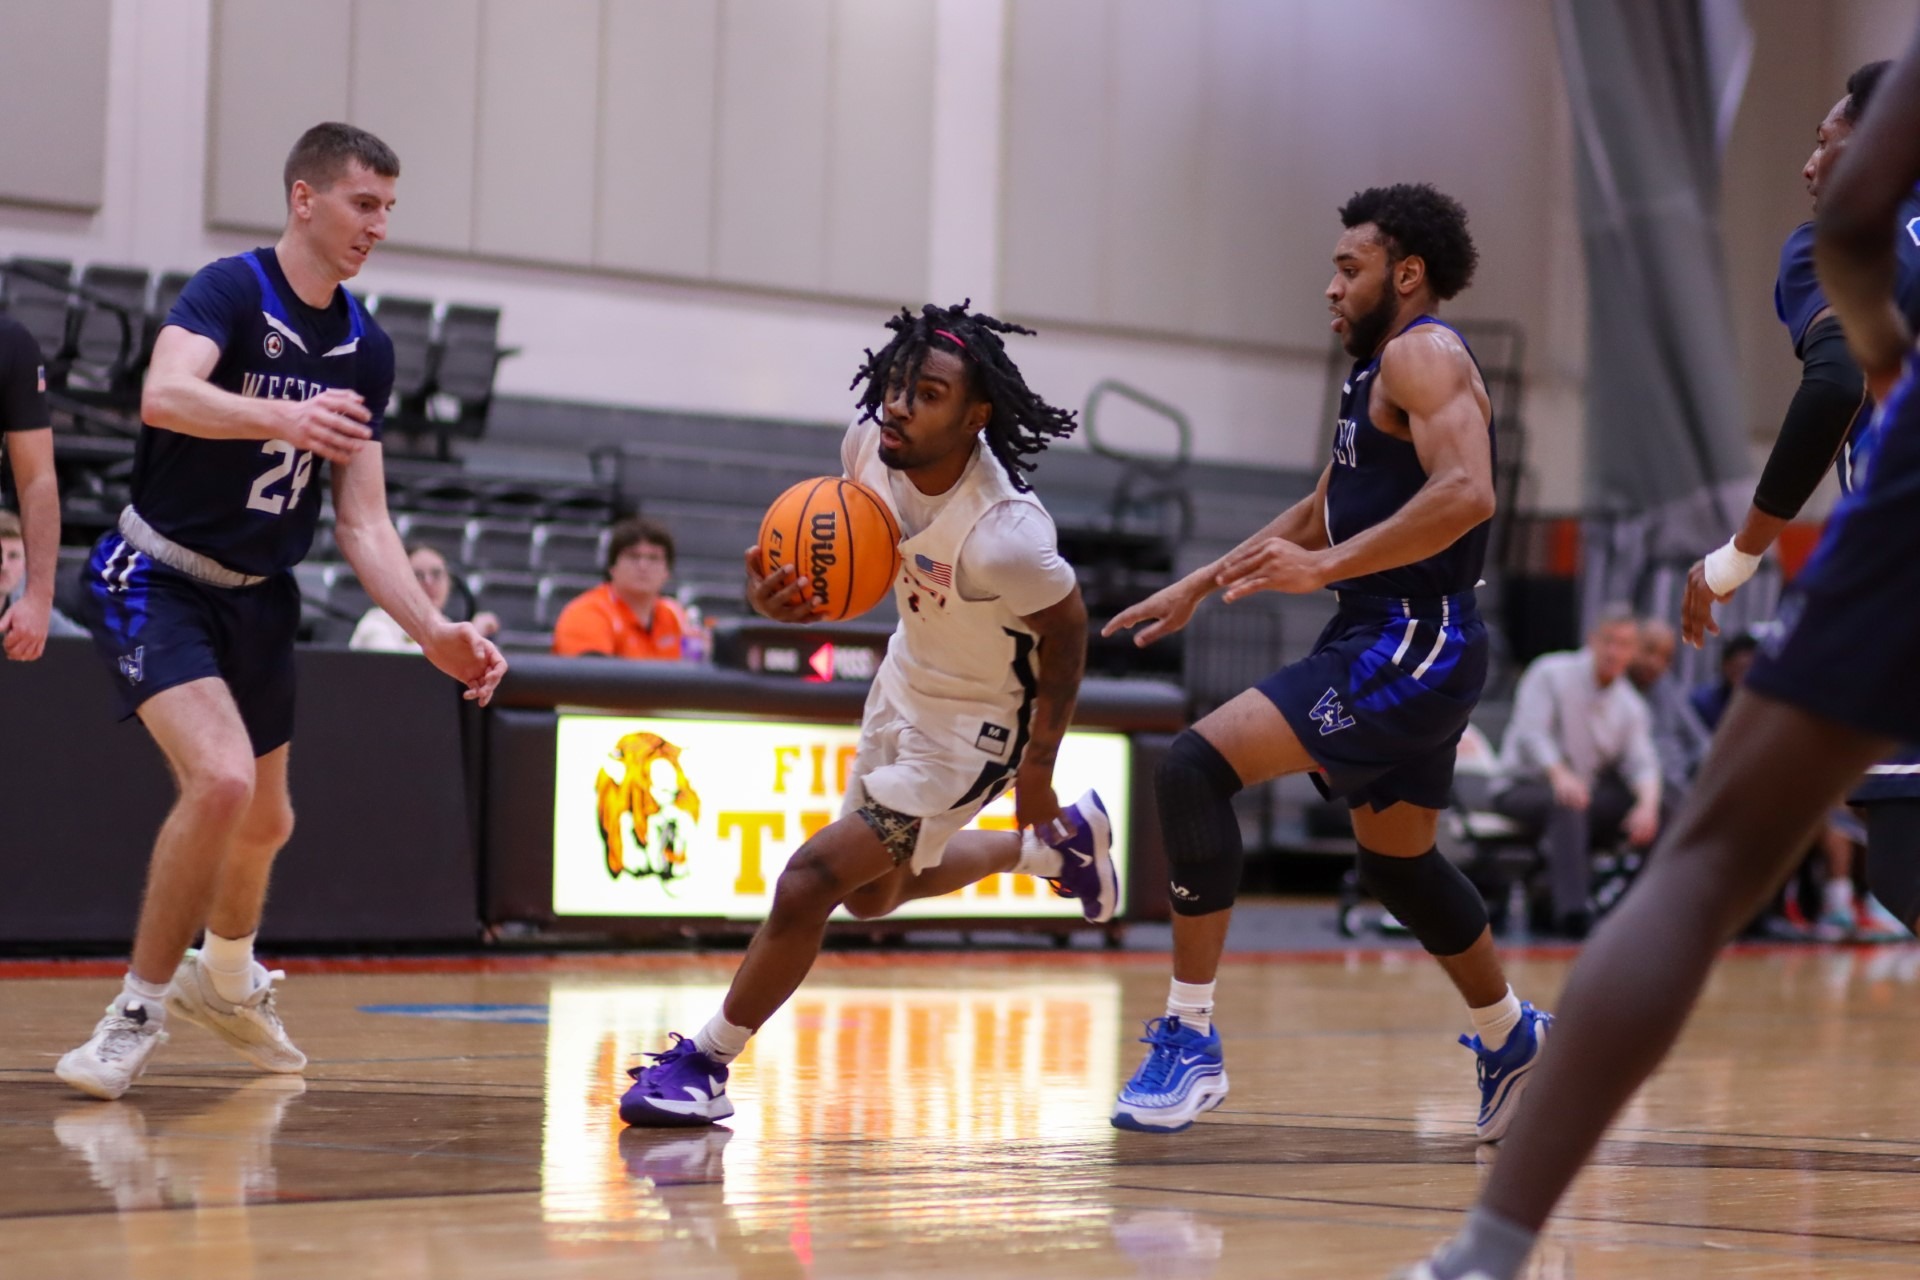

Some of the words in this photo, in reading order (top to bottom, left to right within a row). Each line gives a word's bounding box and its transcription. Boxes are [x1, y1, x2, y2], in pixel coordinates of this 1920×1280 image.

[246, 439, 313, 515] 24
[768, 528, 783, 572] EV
[811, 511, 836, 606] Wilson
